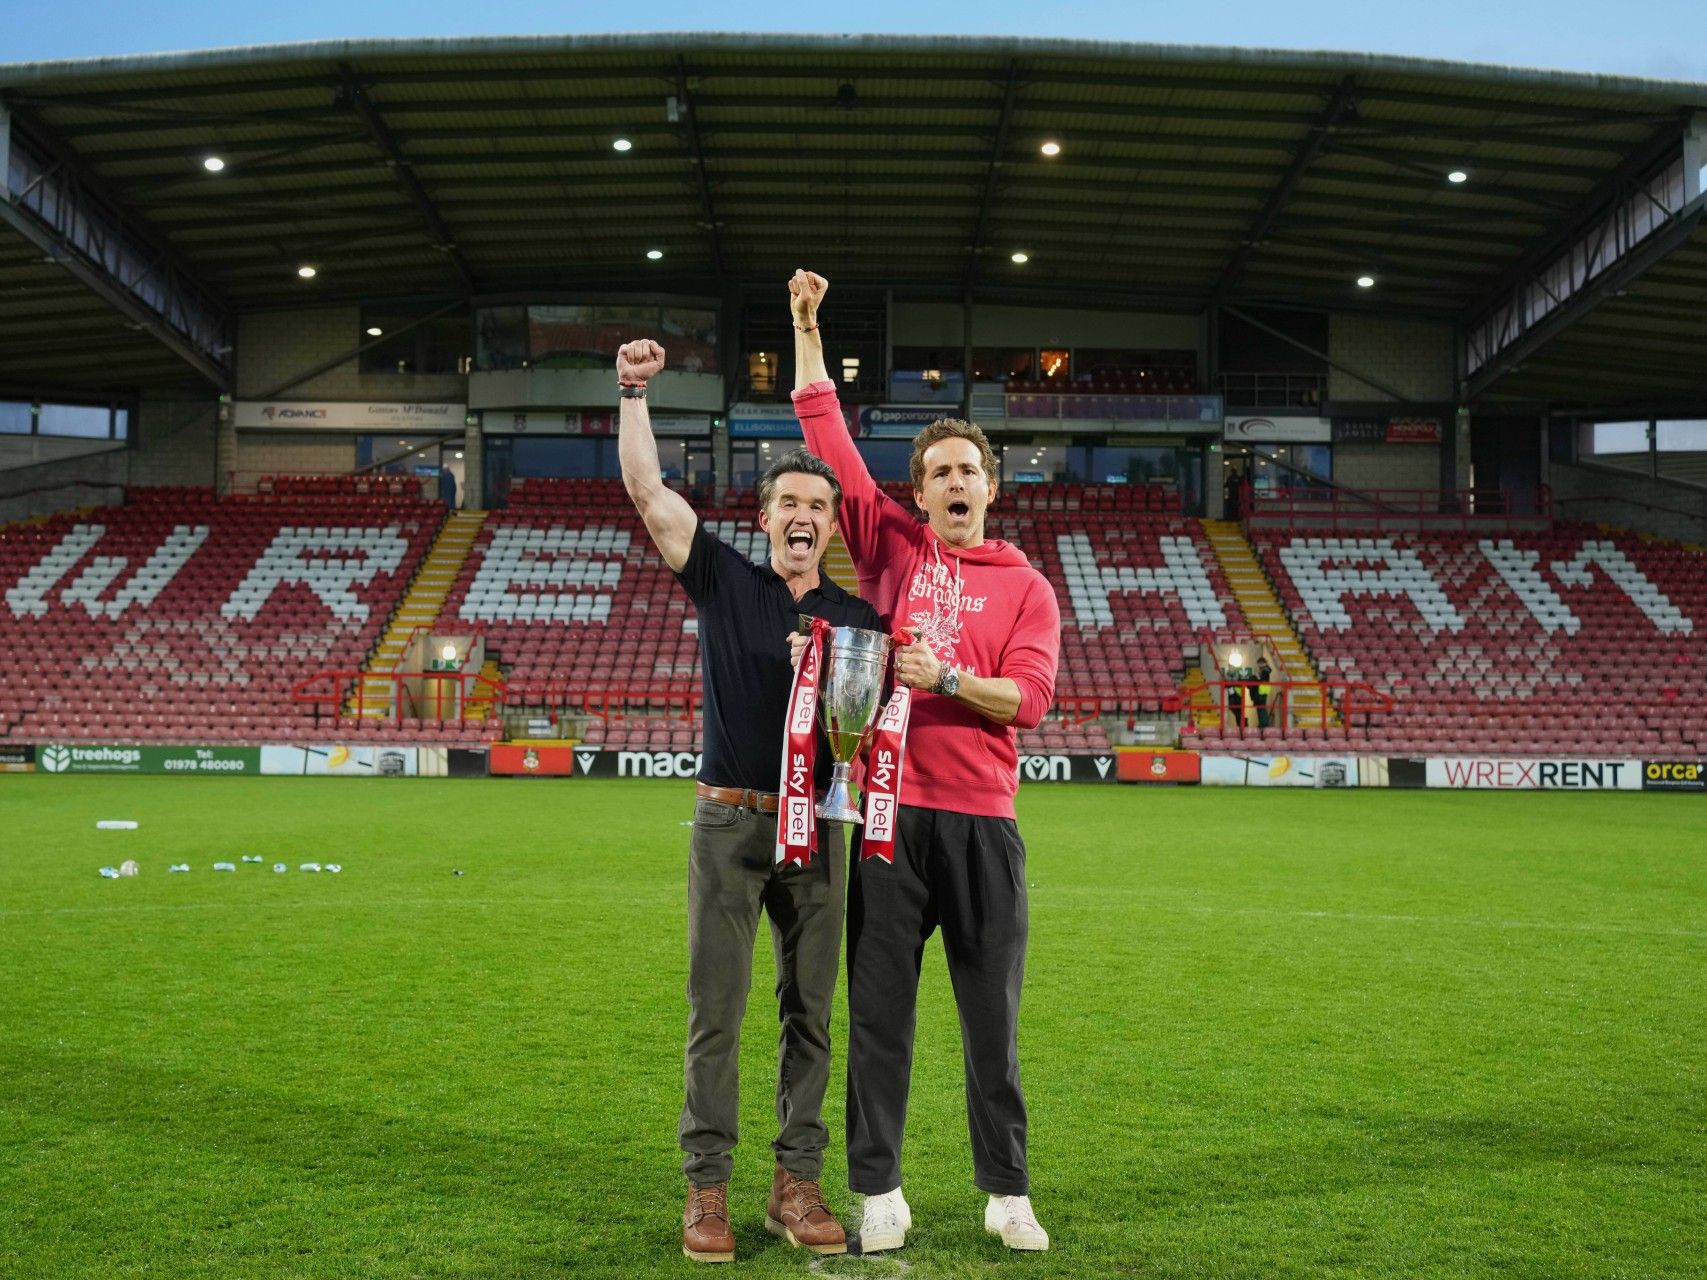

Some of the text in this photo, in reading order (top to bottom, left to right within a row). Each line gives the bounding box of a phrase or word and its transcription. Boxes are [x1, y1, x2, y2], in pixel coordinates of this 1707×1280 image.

[883, 690, 907, 727] bet
[72, 747, 141, 764] treehogs
[164, 759, 245, 770] 01978 480080
[617, 751, 703, 777] mac
[1444, 761, 1625, 787] WREXRENT
[1646, 763, 1698, 780] orca
[789, 753, 808, 841] sky bet
[871, 749, 896, 836] sky bet
